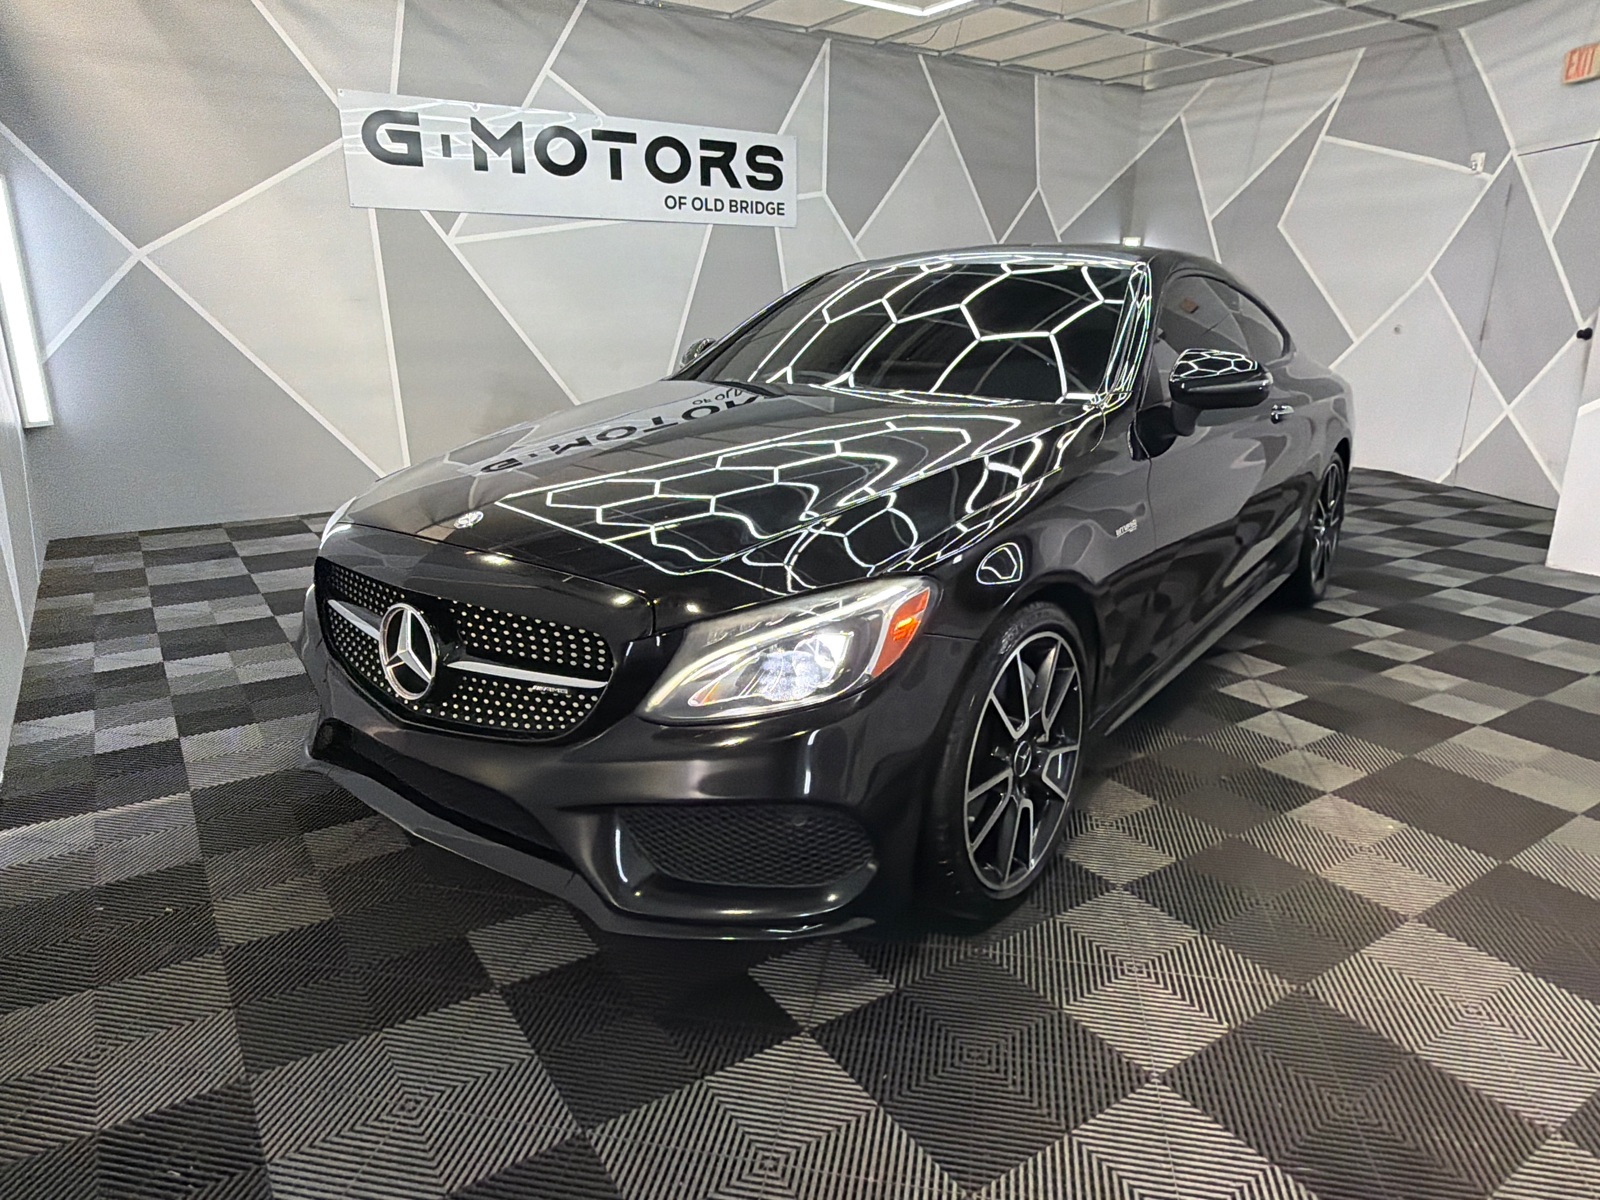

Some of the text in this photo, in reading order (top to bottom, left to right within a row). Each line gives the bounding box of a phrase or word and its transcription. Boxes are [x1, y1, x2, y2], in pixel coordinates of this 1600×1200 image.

[664, 195, 785, 216] OF OLD BRIDGE
